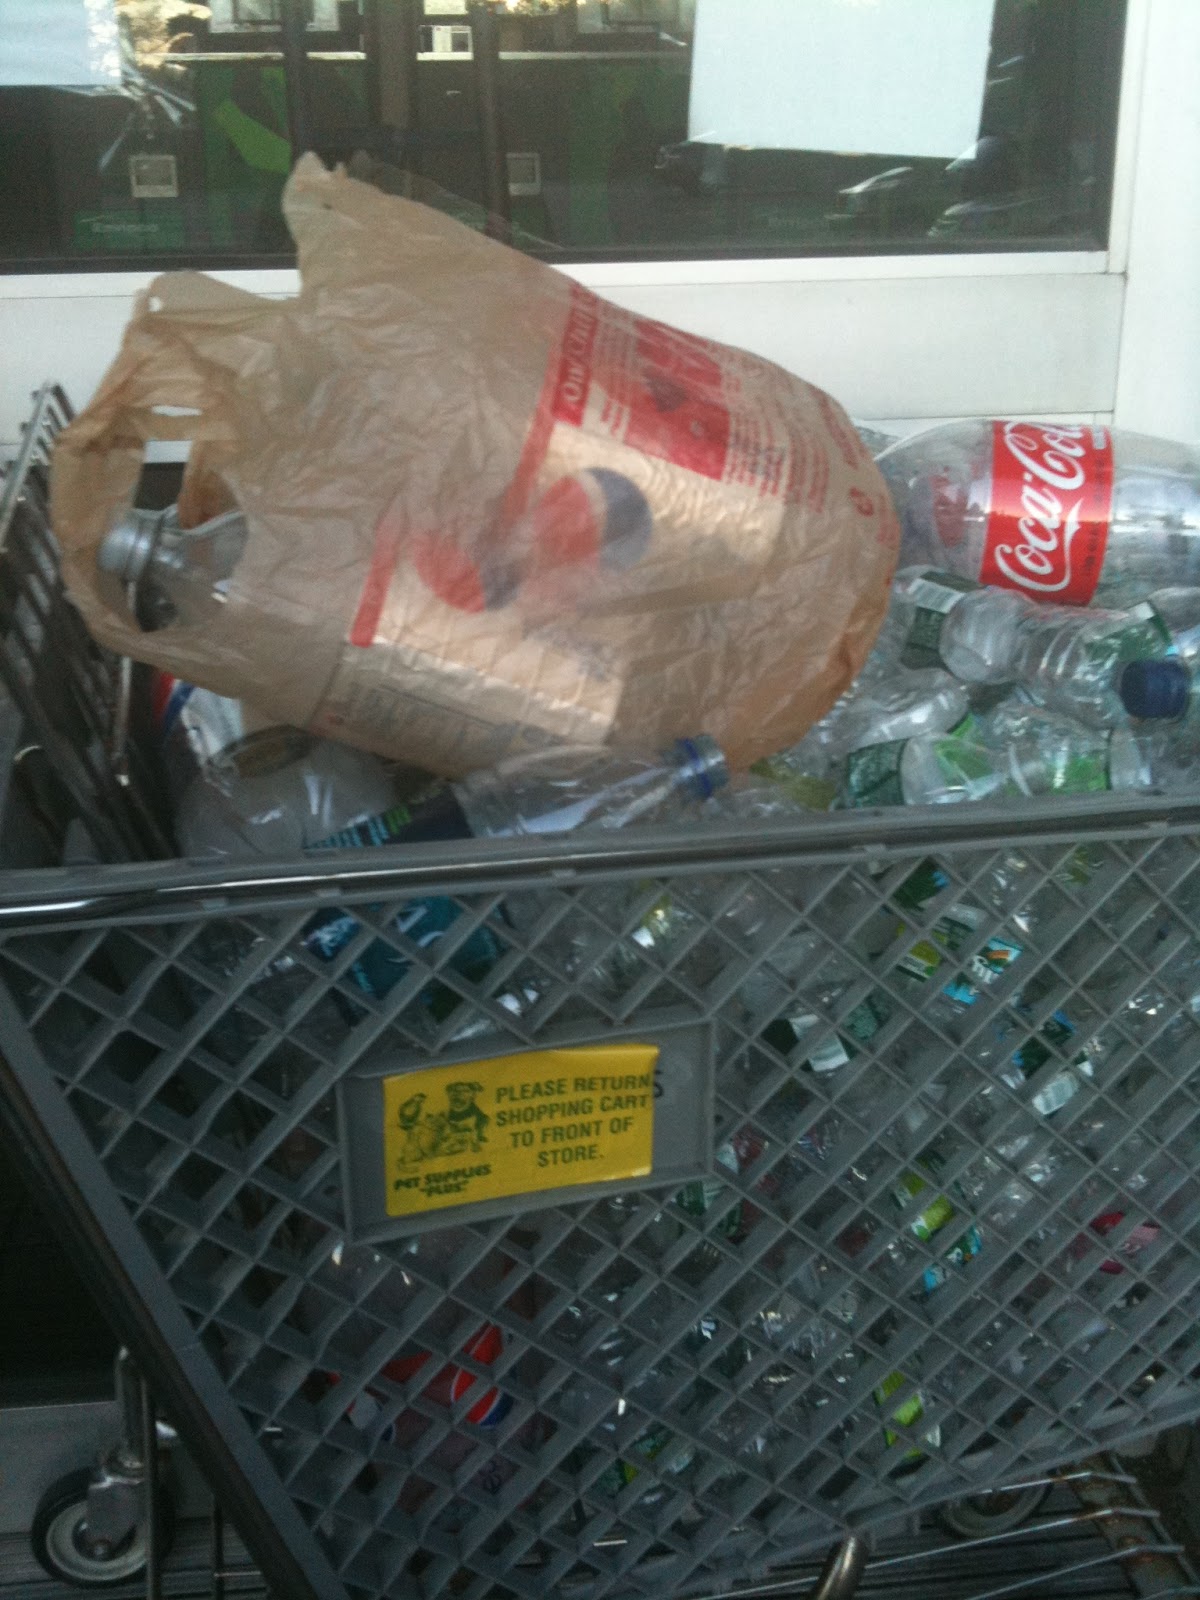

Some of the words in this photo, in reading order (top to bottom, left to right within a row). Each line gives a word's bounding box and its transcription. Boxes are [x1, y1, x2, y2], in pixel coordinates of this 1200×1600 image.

[995, 421, 1086, 592] Coca-Col
[496, 1079, 567, 1104] PLEASE
[573, 1073, 652, 1093] RETURN
[495, 1098, 594, 1128] SHOPPING
[599, 1094, 650, 1113] CART
[510, 1130, 535, 1149] TO
[540, 1120, 604, 1144] FRONT
[609, 1117, 634, 1134] OF
[536, 1144, 605, 1168] STORE.
[393, 1176, 421, 1191] PET
[424, 1163, 492, 1184] SUPPLIES
